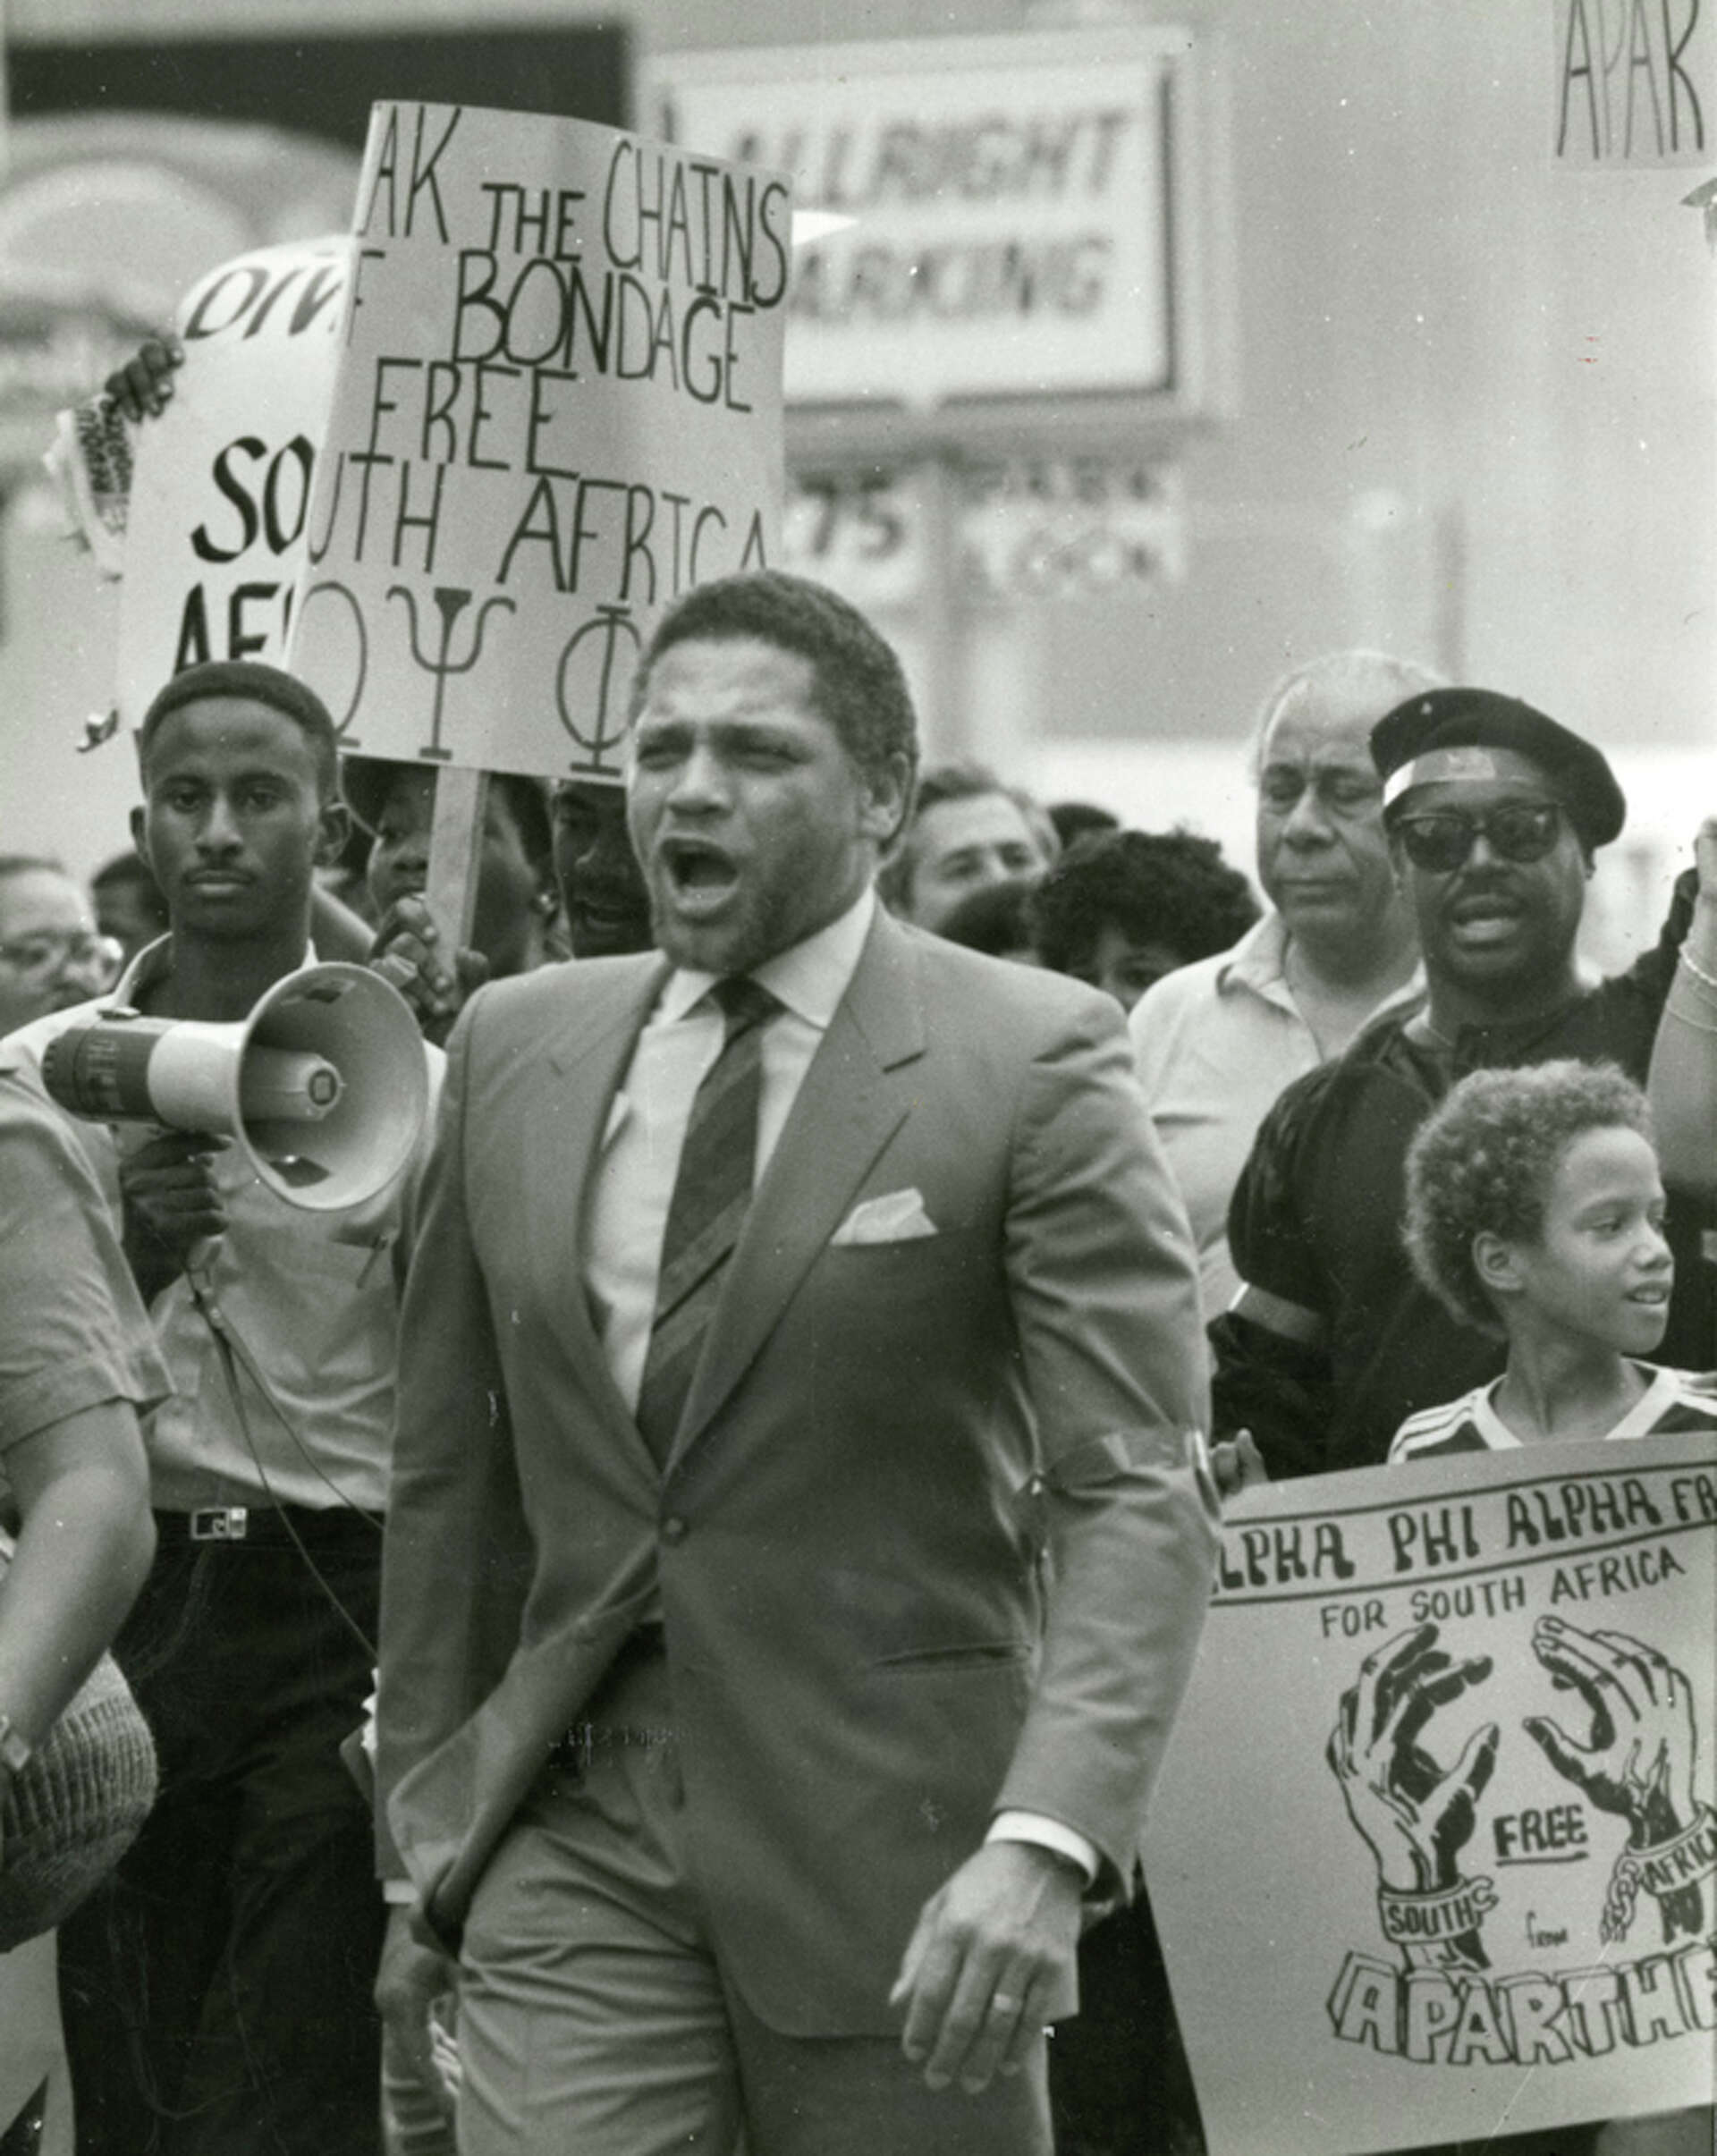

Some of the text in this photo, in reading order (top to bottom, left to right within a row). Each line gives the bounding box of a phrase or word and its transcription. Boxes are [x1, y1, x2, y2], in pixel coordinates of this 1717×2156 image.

[357, 105, 789, 309] AK THE CHAINS
[183, 266, 345, 341] DIV
[452, 249, 757, 413] BONDAGE
[368, 356, 580, 480] FREE
[190, 434, 315, 563] SO
[173, 581, 295, 680] AF
[1212, 1522, 1357, 1595] LPHA
[1388, 1504, 1480, 1572] PHI
[1506, 1477, 1662, 1550] ALPHA
[1320, 1545, 1687, 1638] FOR SOUTH AFRICA
[1493, 1804, 1589, 1859] FREE
[1643, 1826, 1715, 1890] AFRIC
[1387, 1896, 1476, 1936] SOUTH
